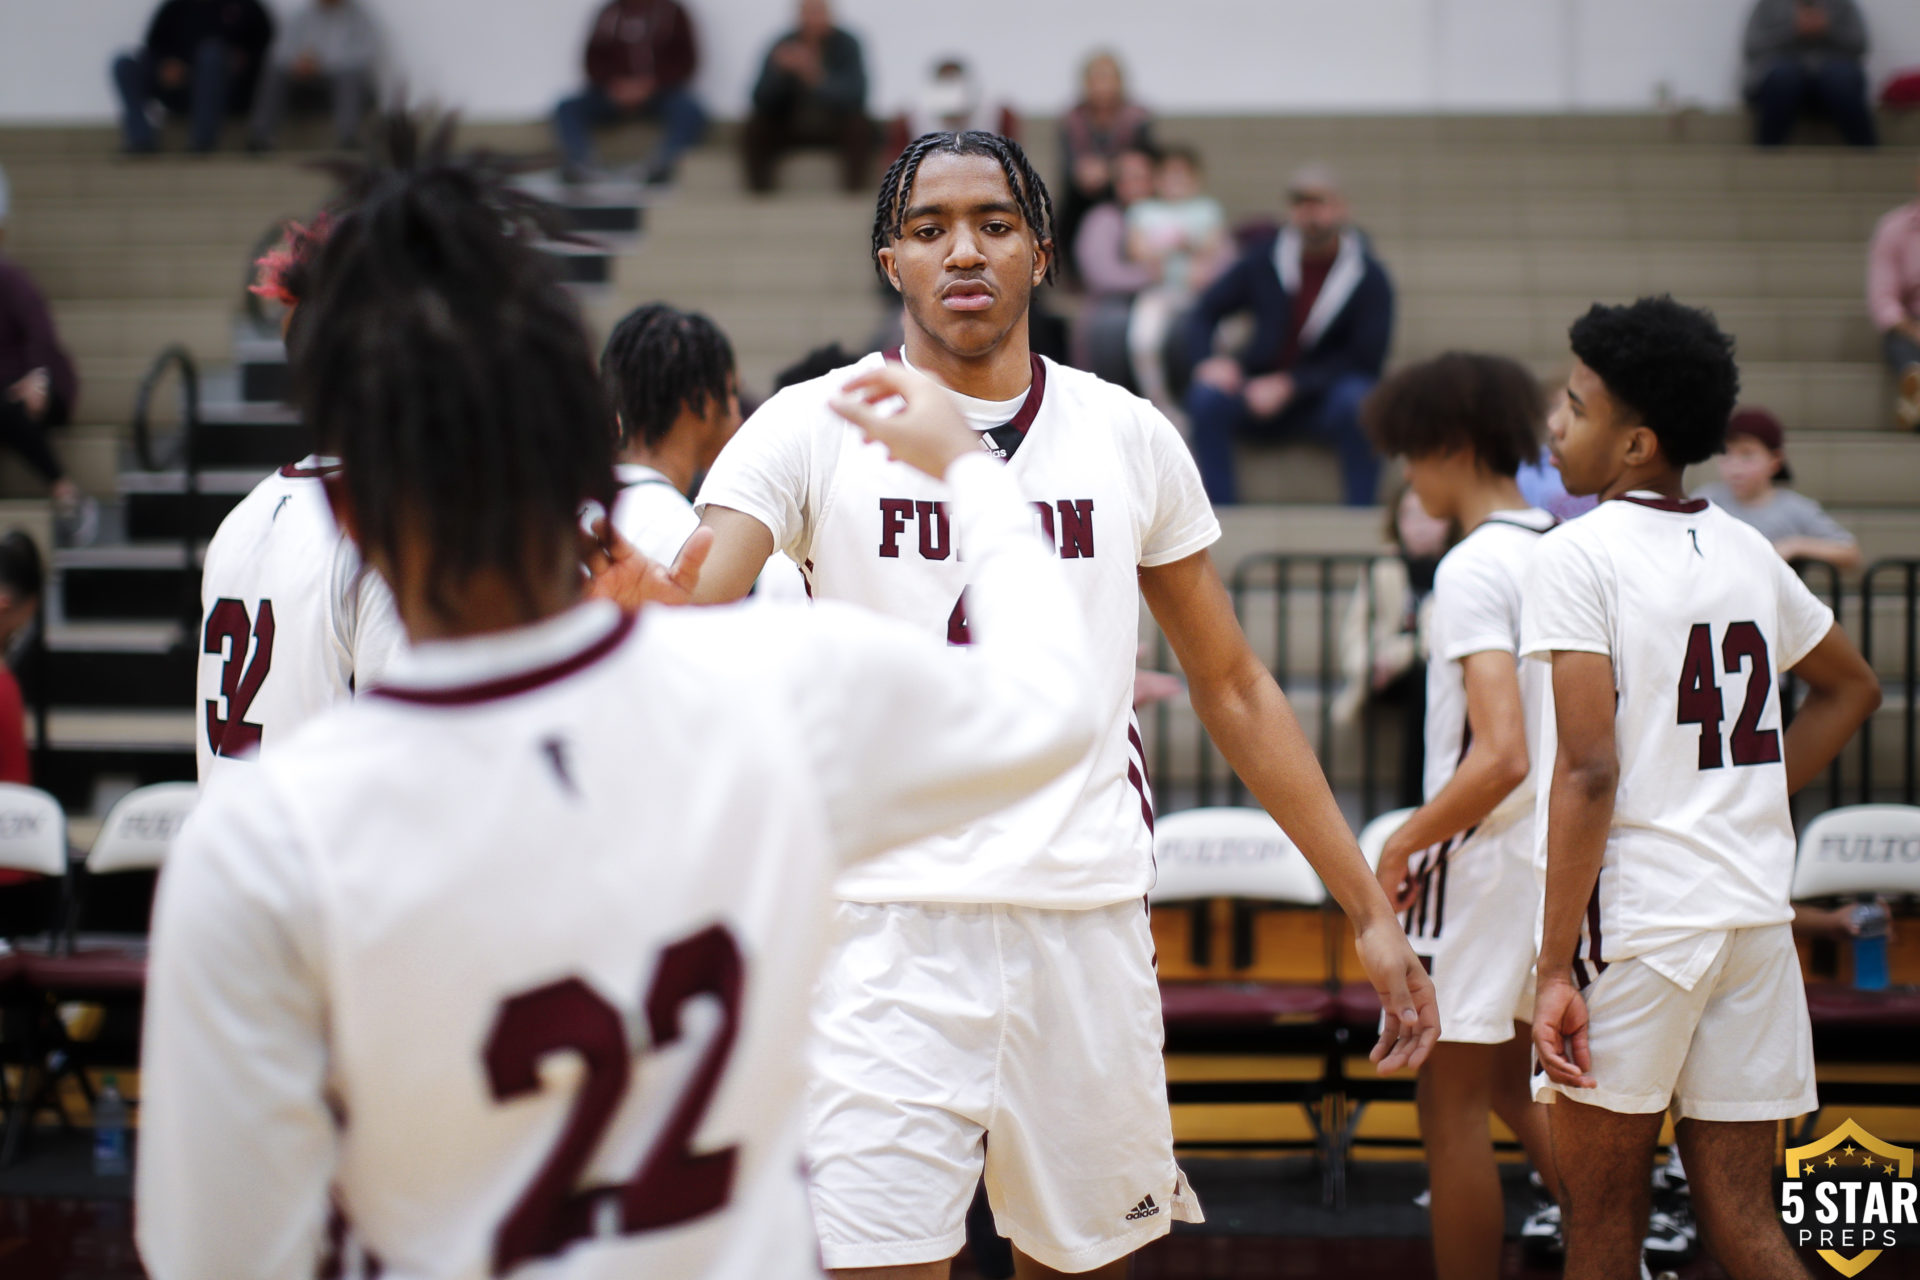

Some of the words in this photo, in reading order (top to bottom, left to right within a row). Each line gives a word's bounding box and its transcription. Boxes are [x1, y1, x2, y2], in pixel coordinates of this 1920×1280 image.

[879, 498, 1095, 561] FUN
[204, 597, 275, 762] 32
[1677, 621, 1782, 771] 42
[483, 923, 745, 1280] 22
[1125, 1206, 1160, 1220] adidas
